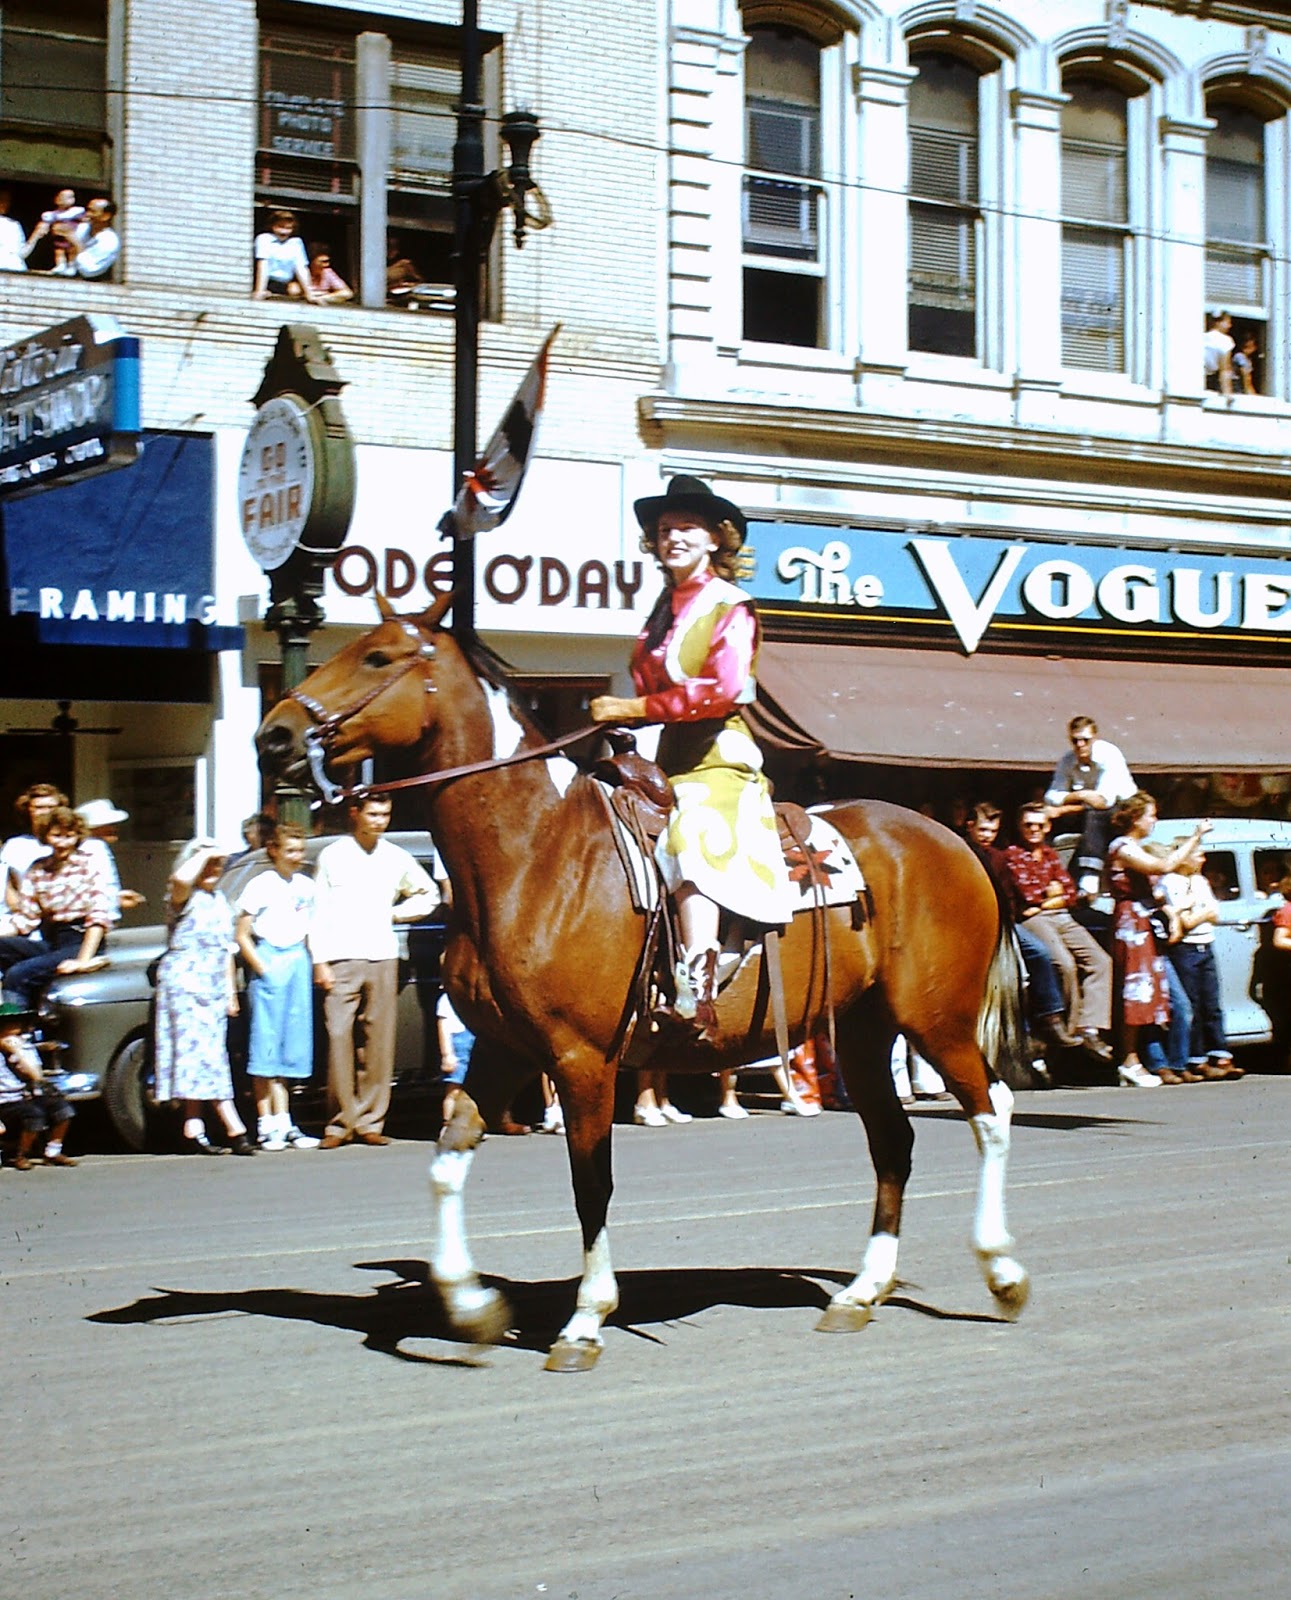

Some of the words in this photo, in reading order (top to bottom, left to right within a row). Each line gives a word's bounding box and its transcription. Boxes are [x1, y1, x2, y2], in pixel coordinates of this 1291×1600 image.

[243, 484, 302, 533] FAIR
[10, 587, 217, 625] FRAMING
[778, 541, 884, 607] The
[910, 539, 1291, 654] VOGUE
